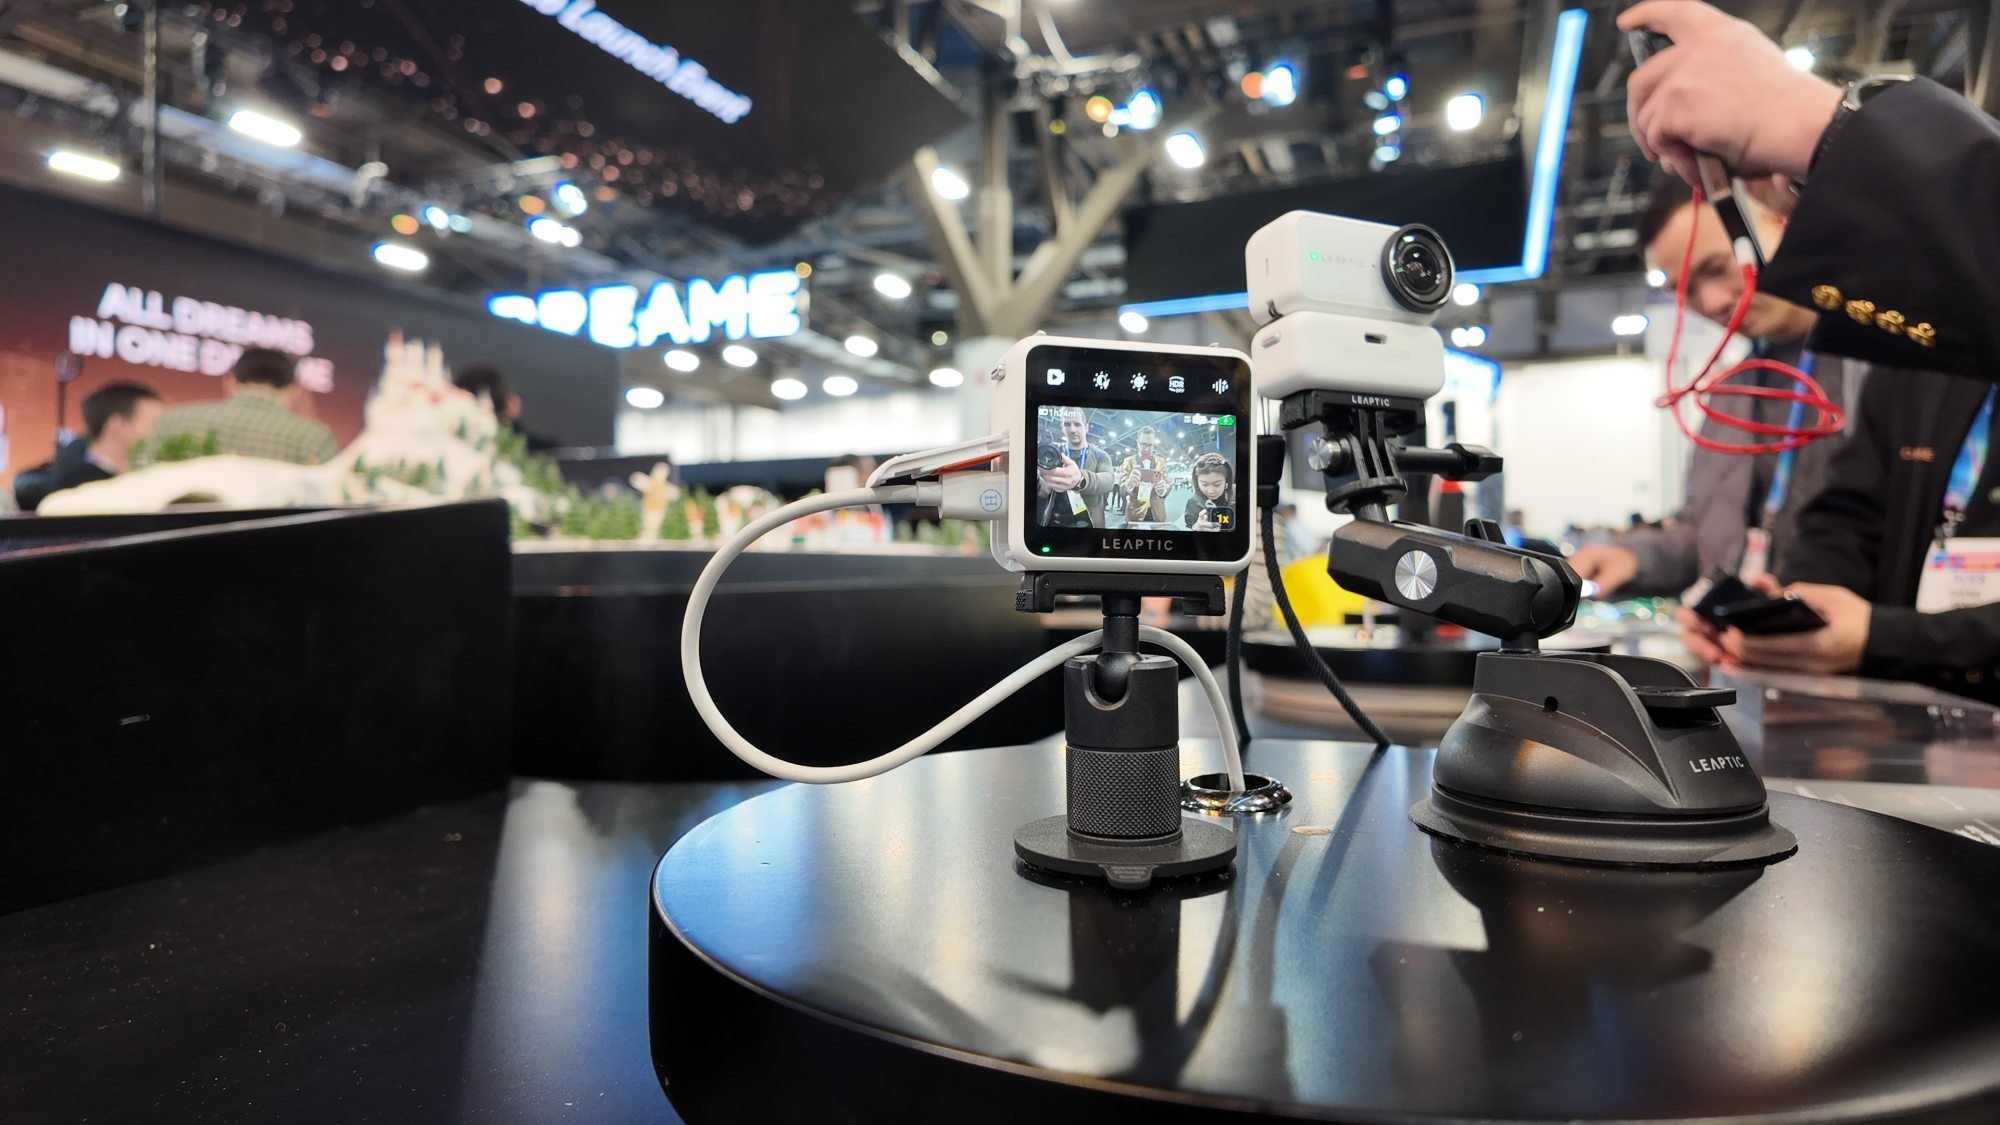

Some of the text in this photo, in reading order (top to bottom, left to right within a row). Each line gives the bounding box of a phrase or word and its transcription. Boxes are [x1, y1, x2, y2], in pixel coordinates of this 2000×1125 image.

[97, 282, 314, 356] ALL DREAMS
[69, 315, 115, 359] IN
[115, 325, 199, 373] ONE
[1169, 380, 1185, 388] HDR
[1351, 394, 1391, 407] LEAPTIC
[1216, 513, 1230, 524] 1x
[1102, 537, 1174, 551] LEAPTIC
[1688, 756, 1744, 773] LEAPTIC
